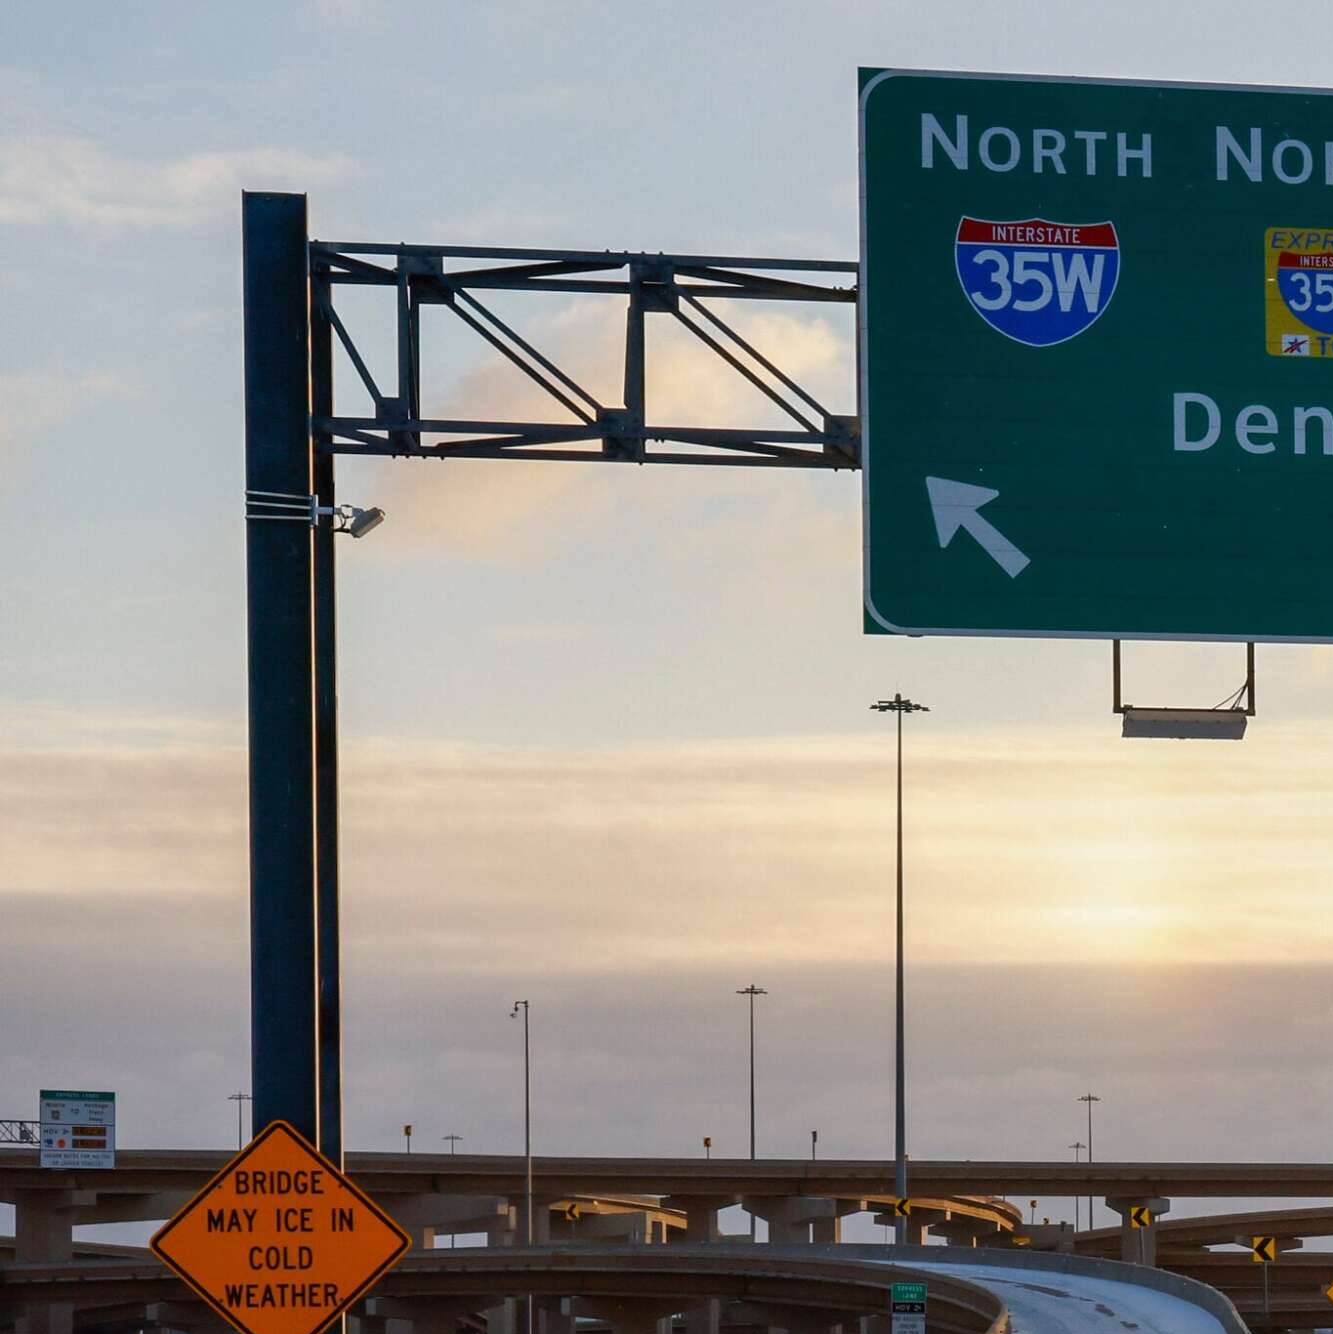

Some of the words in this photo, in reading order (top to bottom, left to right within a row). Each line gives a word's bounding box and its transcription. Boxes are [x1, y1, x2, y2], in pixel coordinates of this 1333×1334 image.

[920, 112, 1152, 178] NORTH
[991, 225, 1081, 244] INTERSTATE
[970, 249, 1106, 313] 35W
[235, 1170, 325, 1195] BRIDGE
[206, 1208, 258, 1233] MAY
[275, 1208, 314, 1233] ICE
[331, 1207, 354, 1232] IN
[249, 1245, 313, 1271] COLD
[224, 1283, 339, 1308] WEATHER
